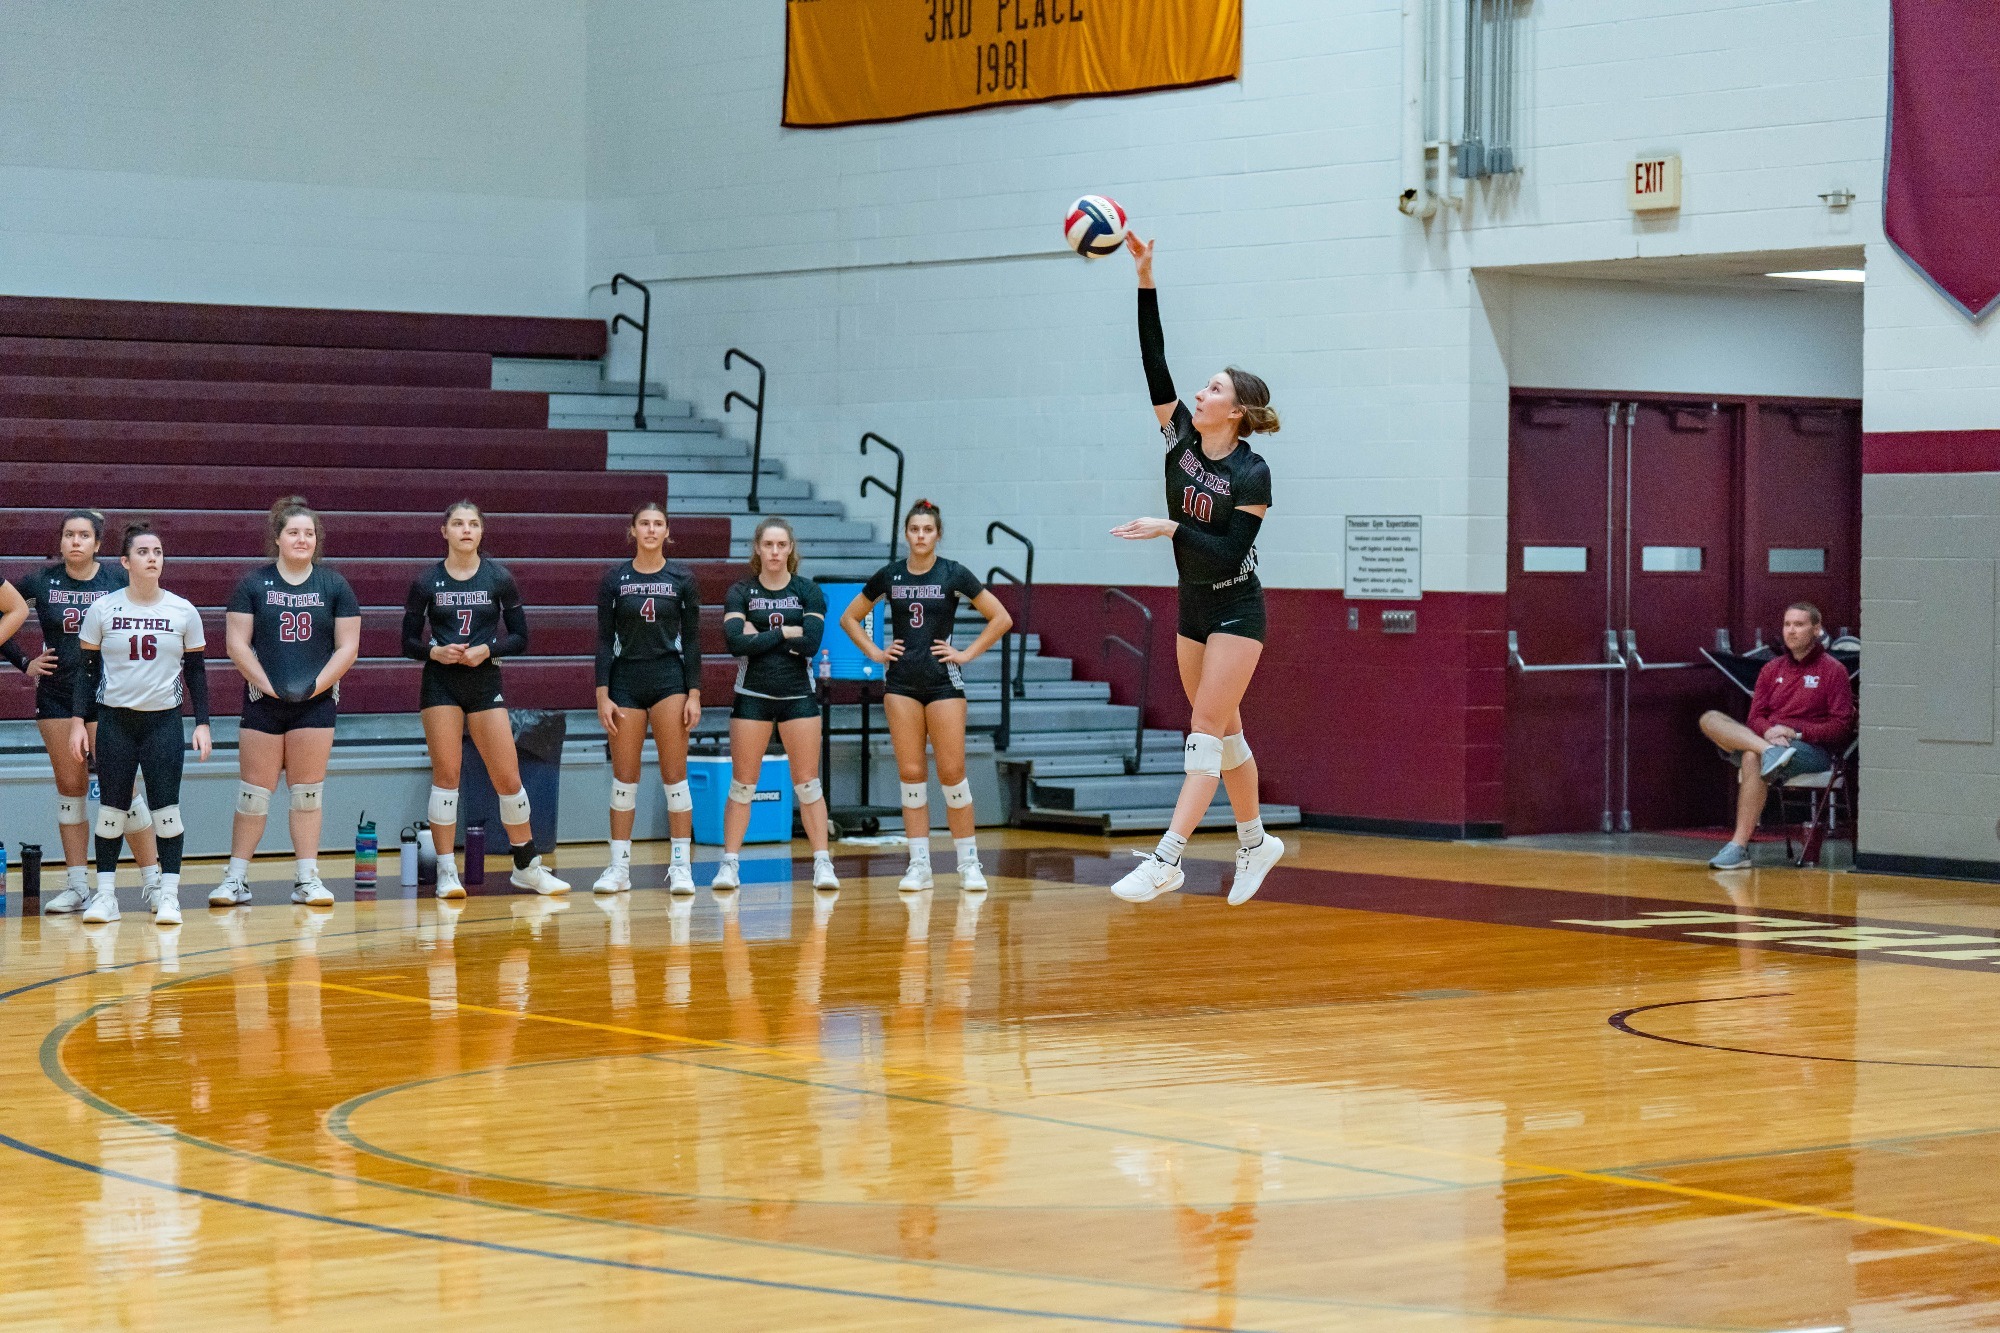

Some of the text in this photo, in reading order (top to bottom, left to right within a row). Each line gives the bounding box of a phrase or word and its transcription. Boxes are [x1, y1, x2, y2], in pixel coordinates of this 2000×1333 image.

[925, 0, 972, 42] 3RD
[976, 39, 1028, 95] 1981
[1635, 161, 1665, 194] EXIT
[1178, 448, 1231, 496] BETHEL
[1182, 485, 1214, 523] 10
[620, 583, 677, 597] BETHEL
[891, 585, 945, 599] BETHEL
[1213, 573, 1249, 591] NIKE PRO
[49, 590, 109, 604] BETHE
[266, 591, 325, 607] BETHEL
[435, 590, 492, 606] BETHEL
[640, 597, 656, 622] 4
[749, 597, 803, 611] BETHEL
[63, 608, 88, 633] 2
[112, 617, 174, 633] BETHEL
[279, 612, 312, 643] 28
[457, 609, 473, 635] 7
[908, 602, 924, 628] 3
[128, 635, 157, 660] 16
